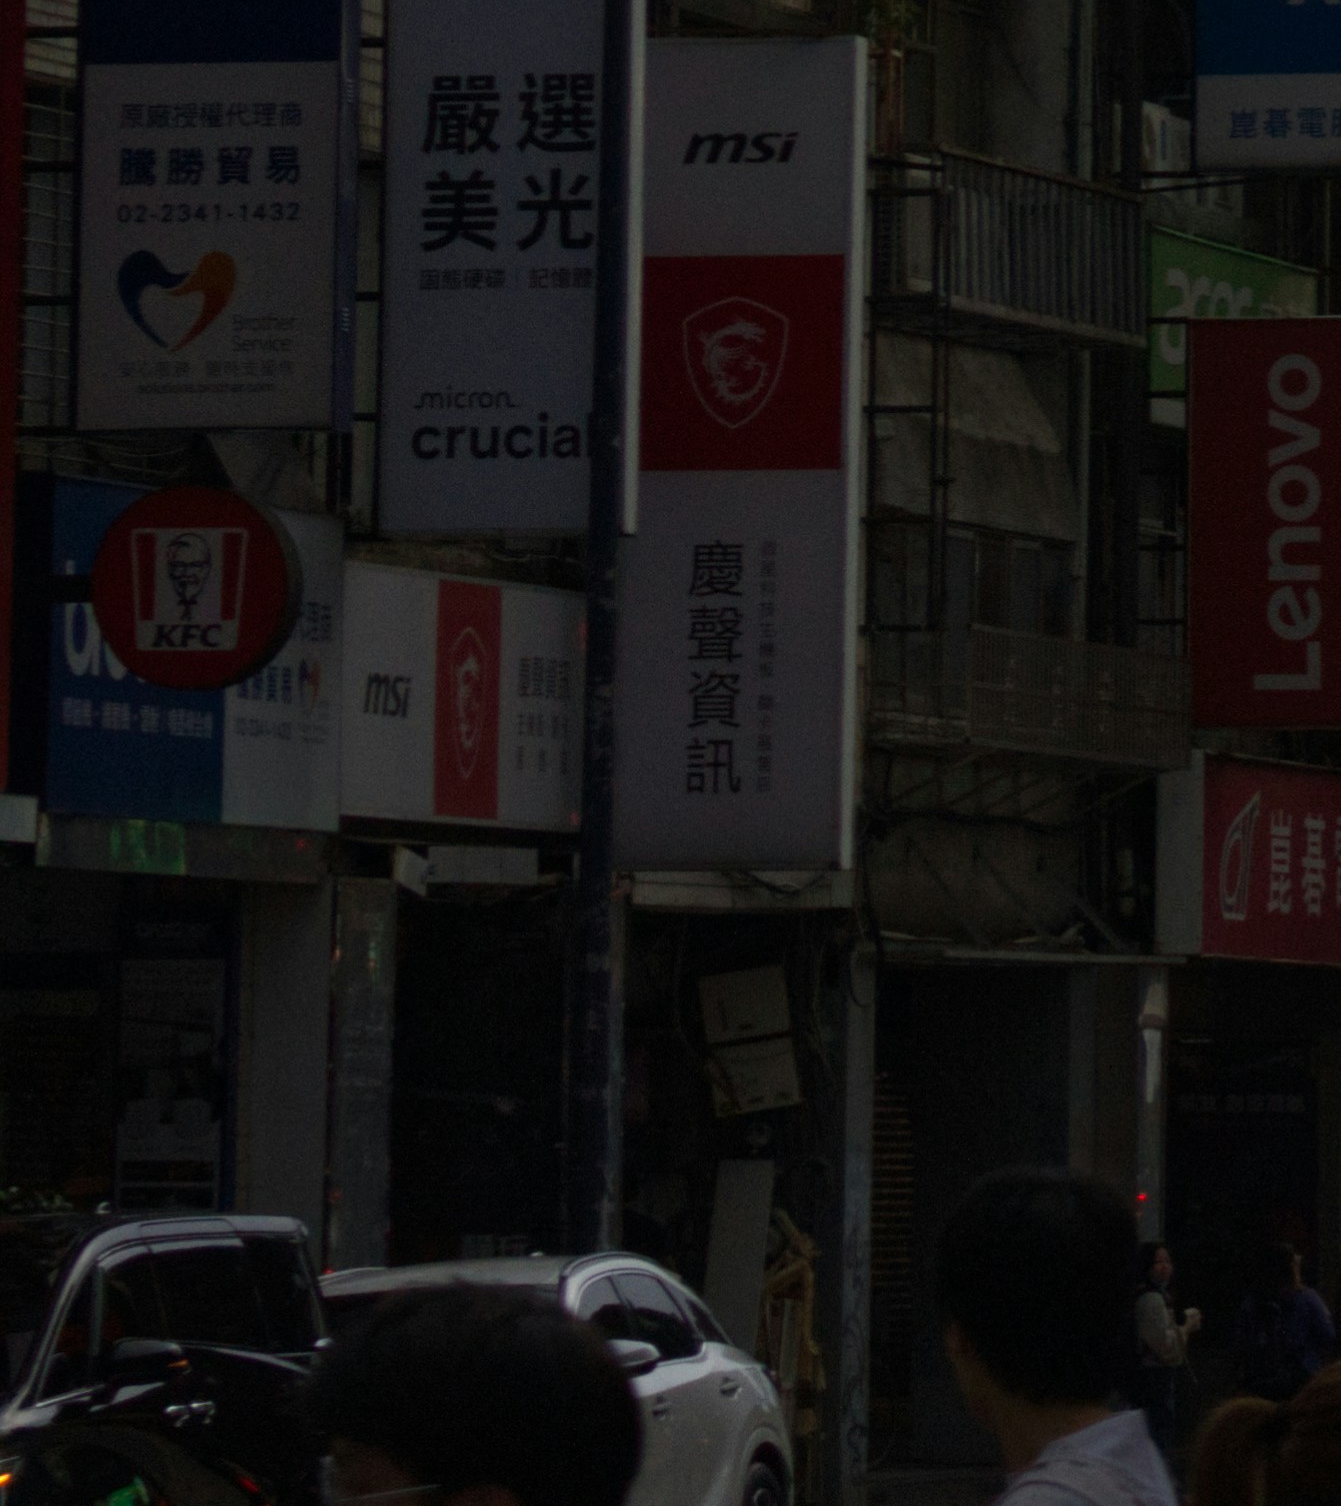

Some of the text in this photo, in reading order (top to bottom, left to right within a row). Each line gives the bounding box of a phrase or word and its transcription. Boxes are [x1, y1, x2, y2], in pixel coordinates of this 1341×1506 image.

[119, 102, 303, 129] 原廠授權代理商
[421, 75, 595, 154] 嚴選
[683, 130, 798, 164] msi
[117, 201, 301, 224] 02-2341-1432
[421, 169, 594, 251] 美光
[414, 385, 516, 410] micron
[1253, 353, 1323, 693] Lenovo
[151, 623, 223, 649] KFC
[685, 539, 745, 795] 慶聲資訊
[363, 672, 413, 718] msi
